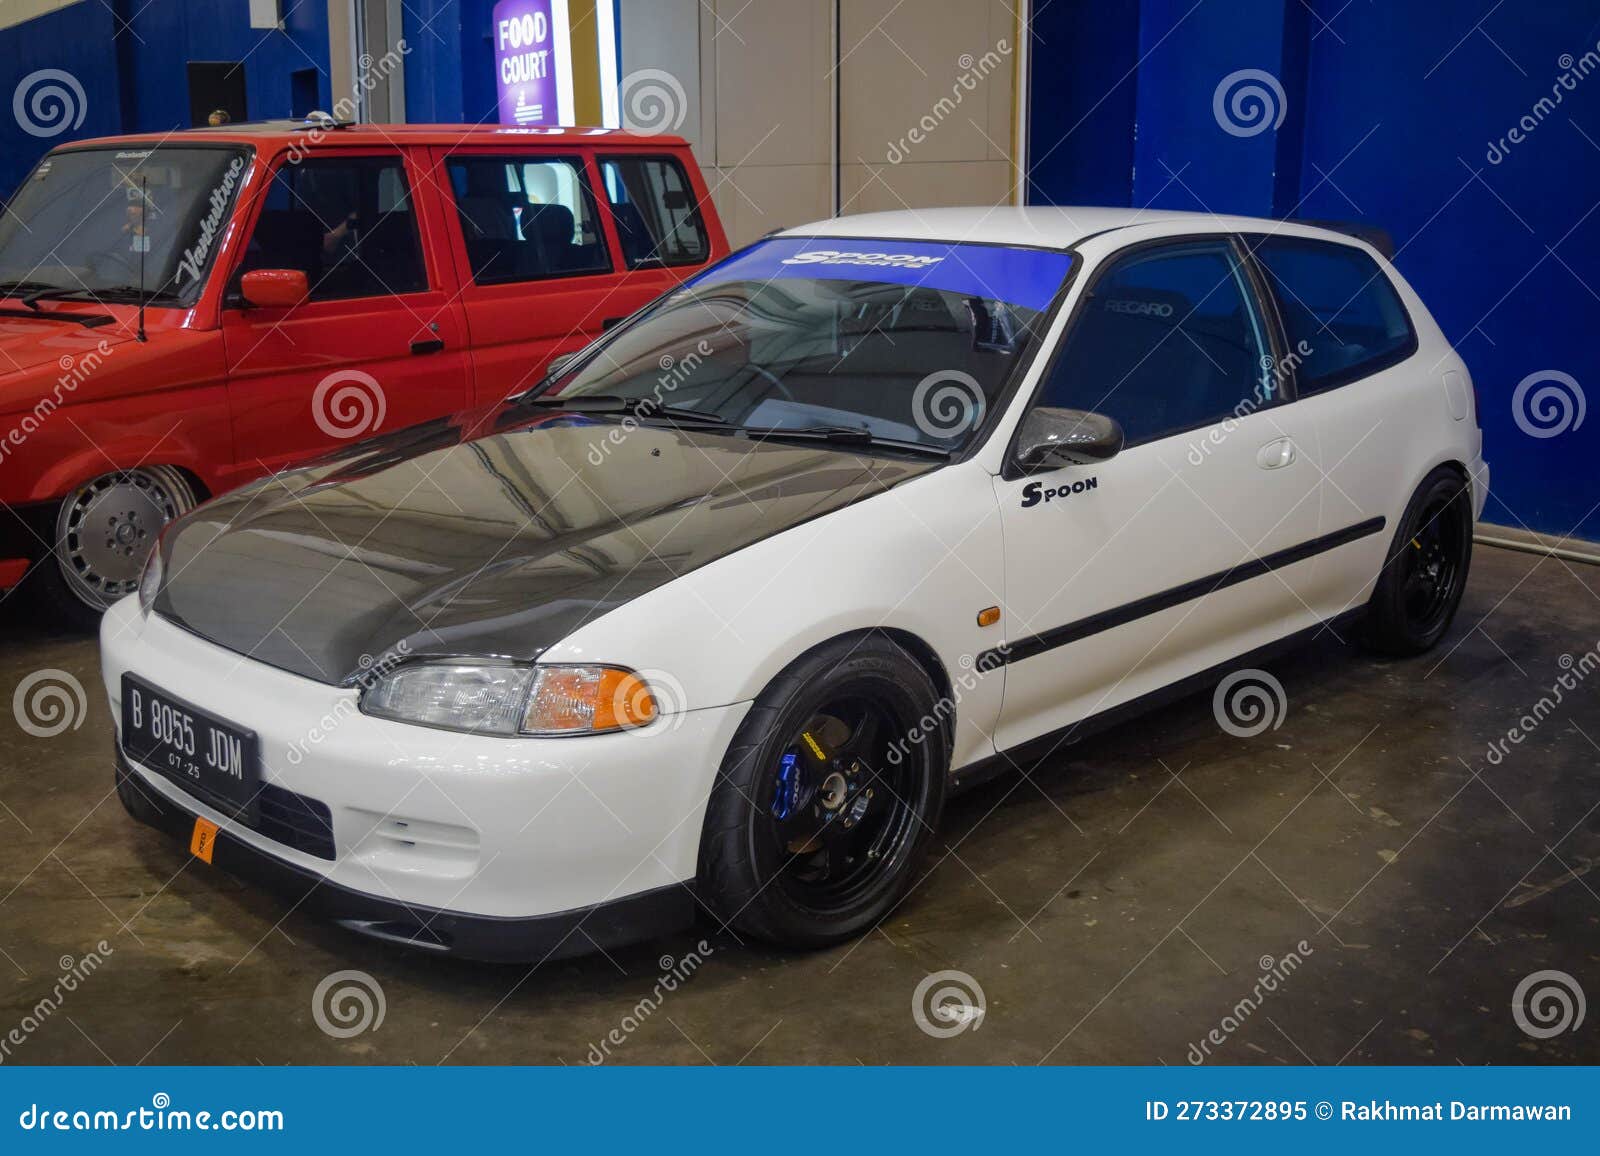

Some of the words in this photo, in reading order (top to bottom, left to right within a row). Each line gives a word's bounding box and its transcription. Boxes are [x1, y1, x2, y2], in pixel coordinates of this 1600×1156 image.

[499, 11, 547, 50] FOOD
[501, 49, 548, 85] COURT
[781, 250, 945, 265] SPOON
[1104, 299, 1174, 317] RECARO
[1021, 476, 1098, 508] SPOON
[132, 688, 143, 729] B
[151, 699, 196, 757] 8055
[206, 727, 243, 781] JDM
